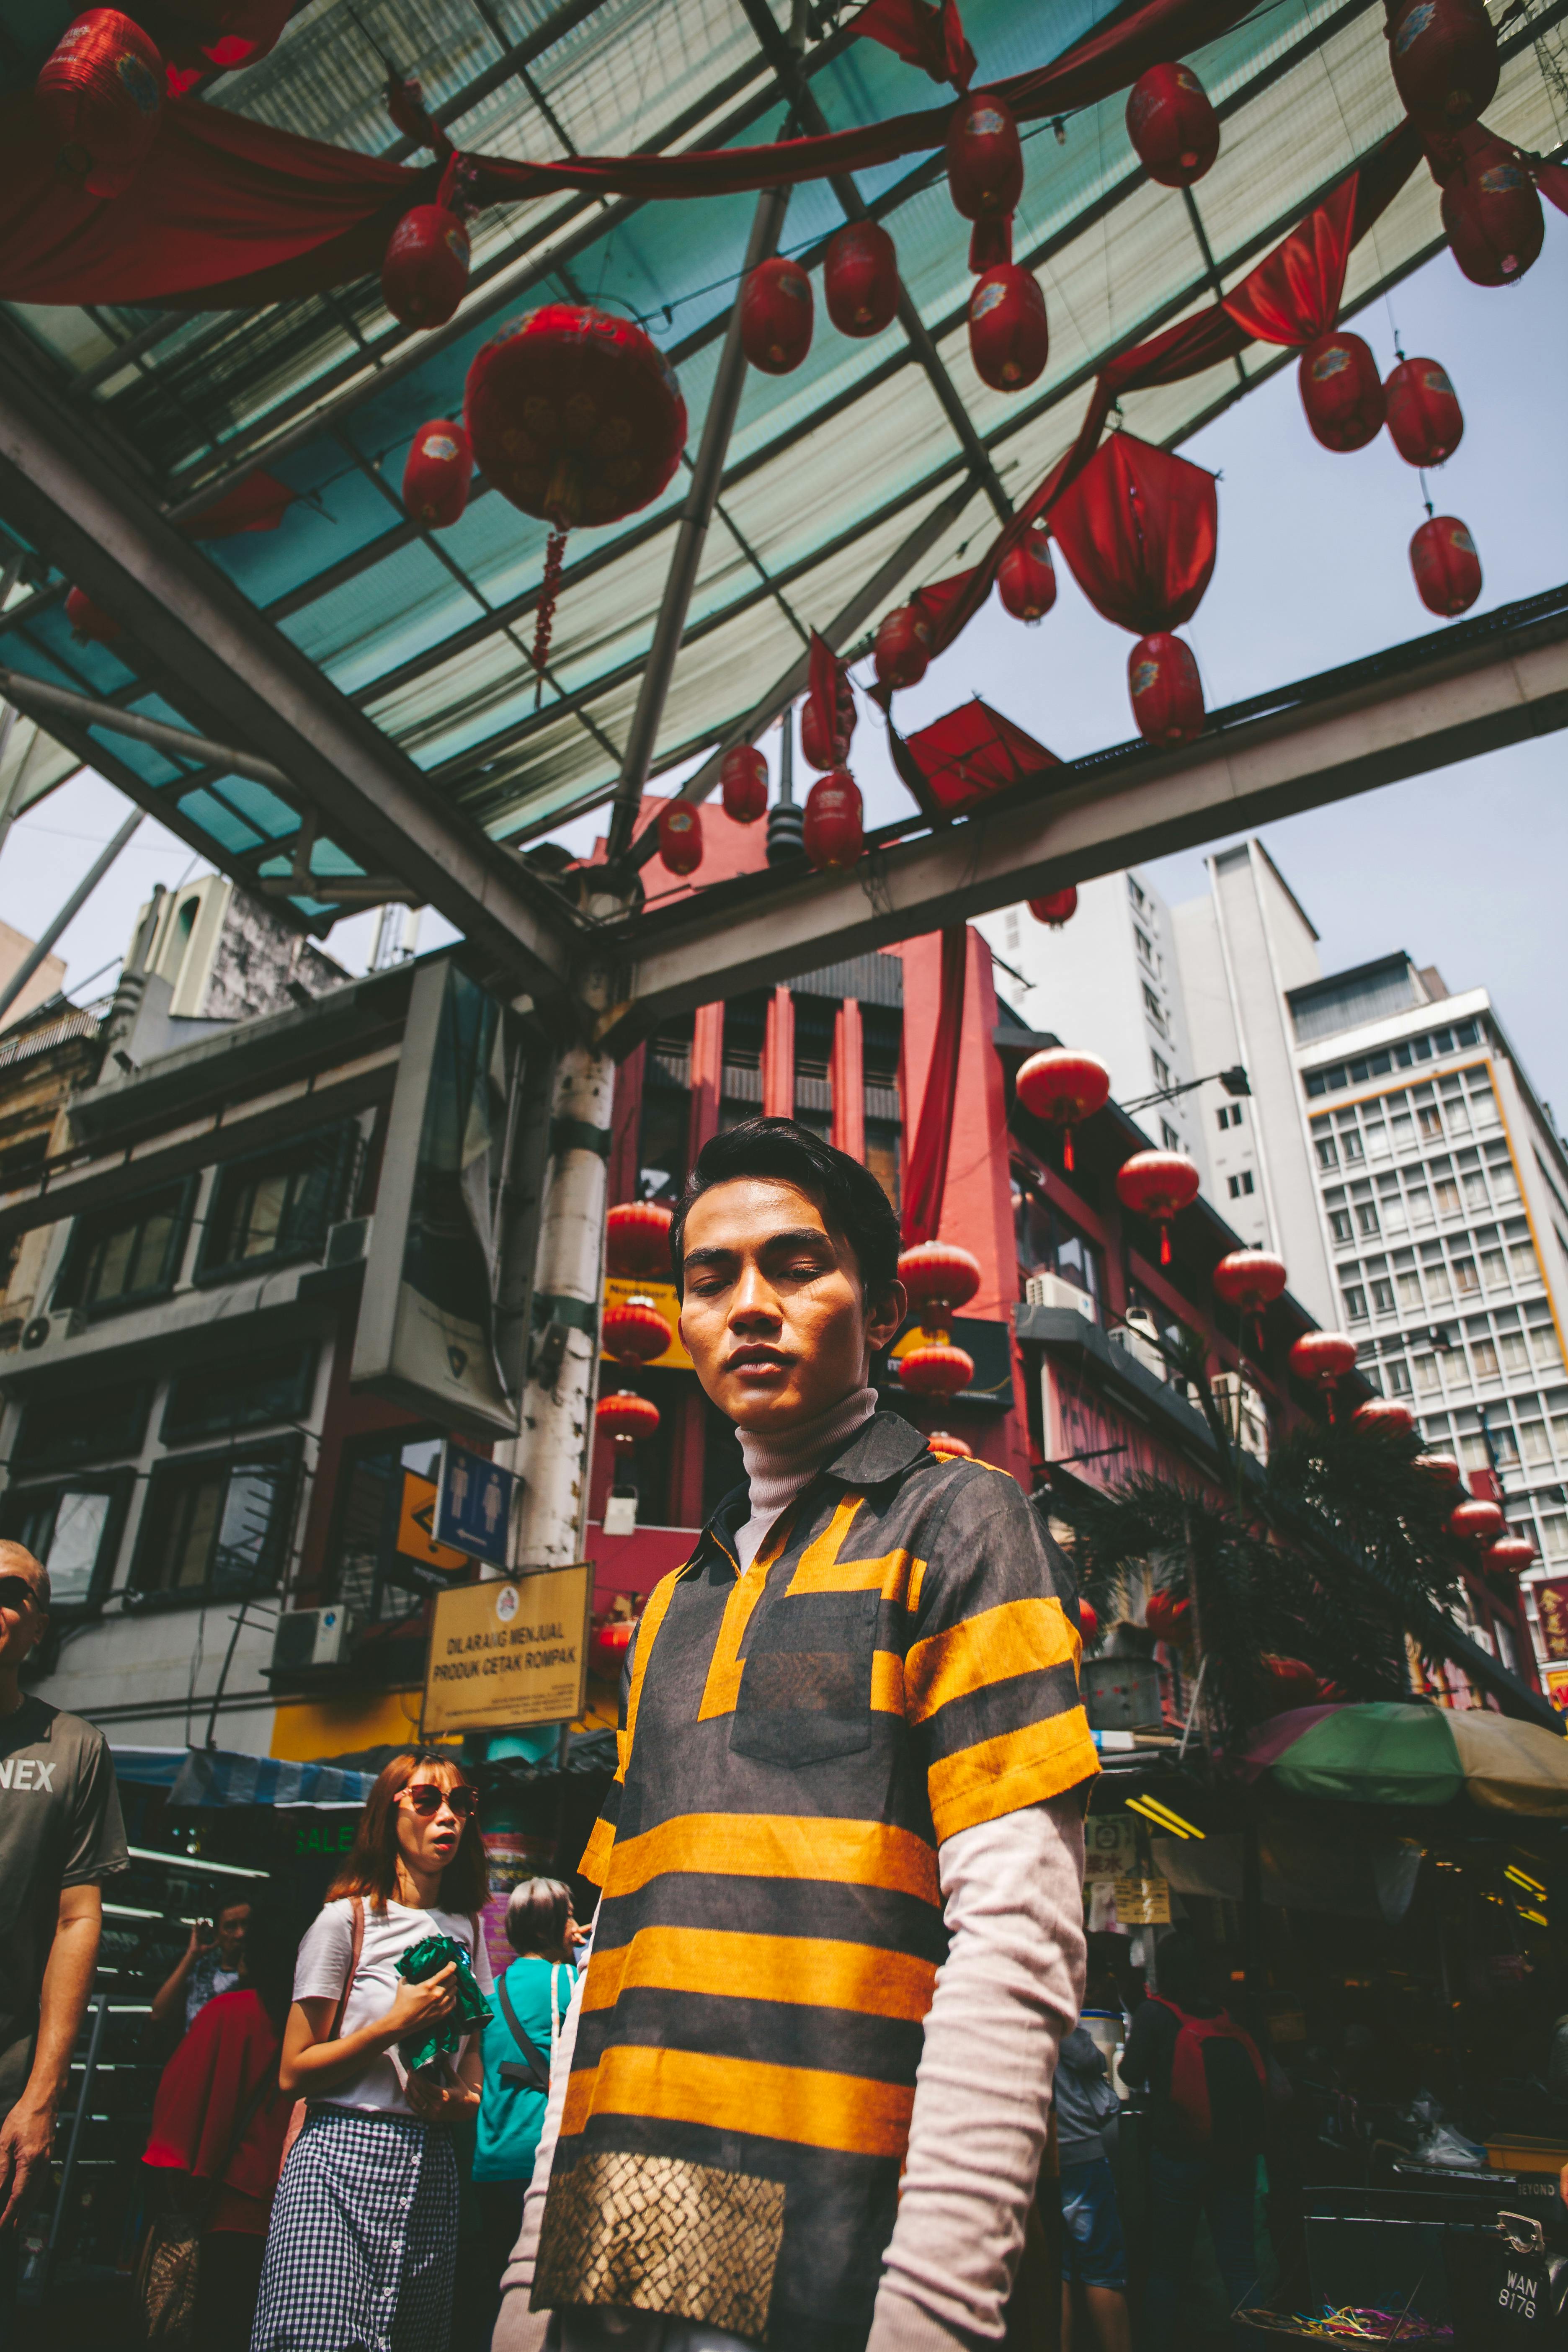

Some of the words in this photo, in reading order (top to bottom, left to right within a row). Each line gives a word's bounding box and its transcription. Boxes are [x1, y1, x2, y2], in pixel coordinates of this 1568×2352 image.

[446, 1630, 508, 1655] DILARANG
[509, 1622, 565, 1645] MENJUAL
[433, 1660, 480, 1682] PRODUK
[482, 1653, 523, 1675] CETAK
[525, 1646, 577, 1669] ROMPAK
[0, 1759, 57, 1793] NEX
[1517, 2183, 1555, 2197] BEYOND
[1507, 2269, 1538, 2299] WAN
[1498, 2288, 1536, 2319] 8176
